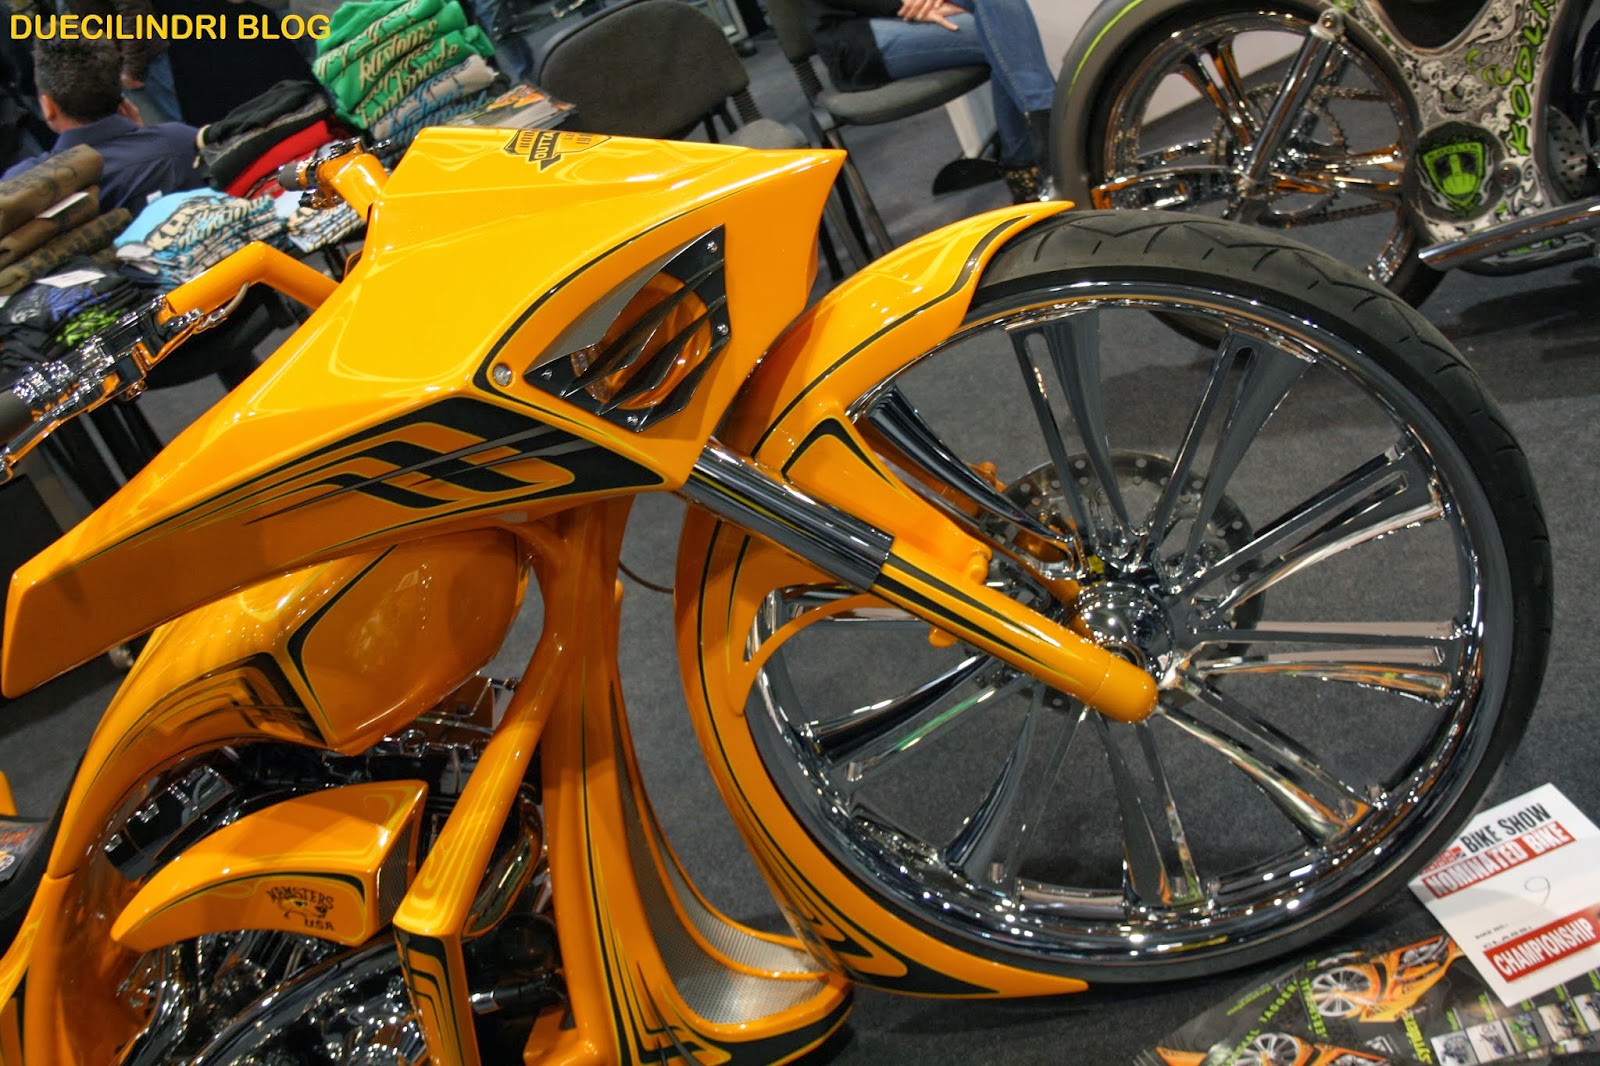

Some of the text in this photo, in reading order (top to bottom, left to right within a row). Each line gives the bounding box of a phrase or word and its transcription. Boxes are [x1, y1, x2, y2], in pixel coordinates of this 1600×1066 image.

[1509, 0, 1553, 156] KODLI
[534, 131, 556, 160] OUTTA
[1461, 802, 1552, 853] BIKE SHOW
[1424, 839, 1529, 896] NOMINATED
[1521, 823, 1570, 854] BIKE
[304, 919, 335, 931] USA
[1492, 917, 1597, 977] CHAMPIONSHIP
